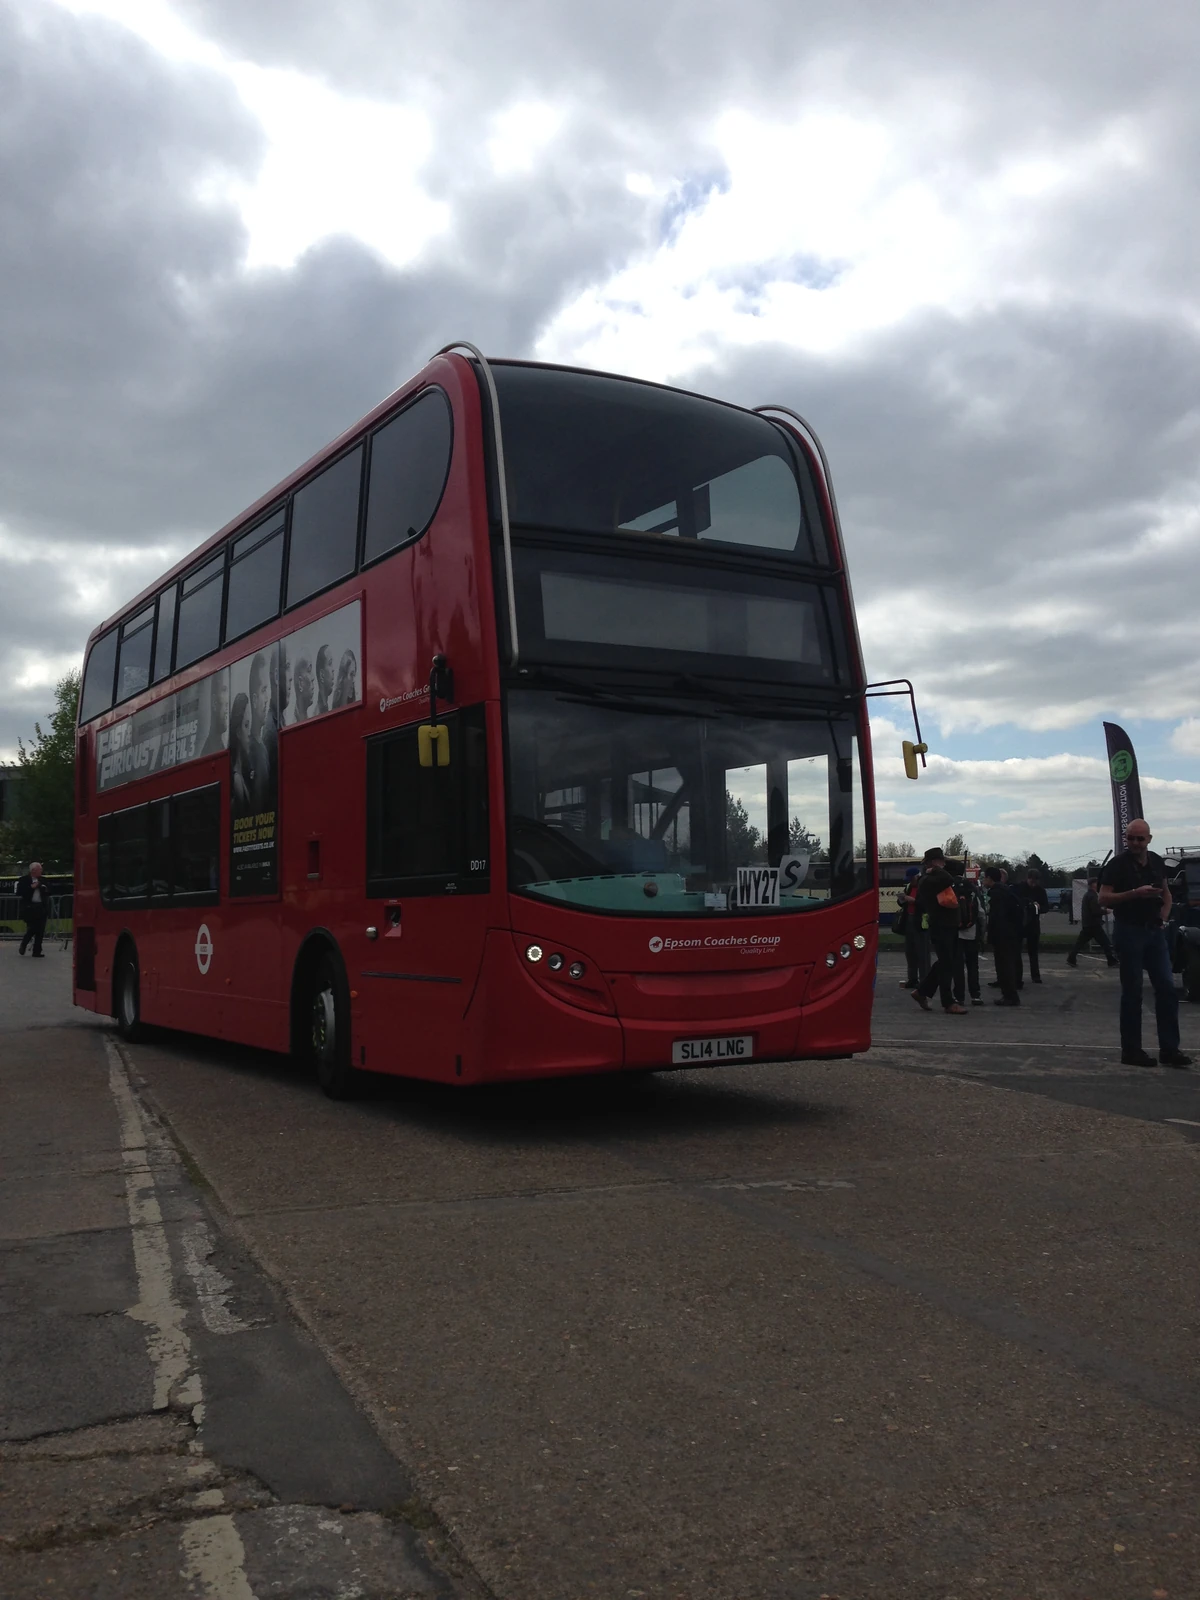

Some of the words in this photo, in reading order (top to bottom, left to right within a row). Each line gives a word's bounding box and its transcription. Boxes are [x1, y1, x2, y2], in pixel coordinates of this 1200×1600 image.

[98, 722, 127, 764] FAST
[161, 737, 187, 767] APRIL
[188, 732, 197, 757] 3
[233, 816, 254, 830] BOOK
[255, 811, 275, 826] YOUR
[233, 829, 257, 844] TICKETS
[258, 826, 275, 840] NOW
[470, 859, 486, 871] DD17
[738, 870, 778, 904] WY27
[664, 937, 702, 949] Epsom
[704, 936, 748, 946] Coaches
[750, 935, 781, 945] Group
[681, 1041, 713, 1059] SL14
[717, 1039, 744, 1057] LNG
